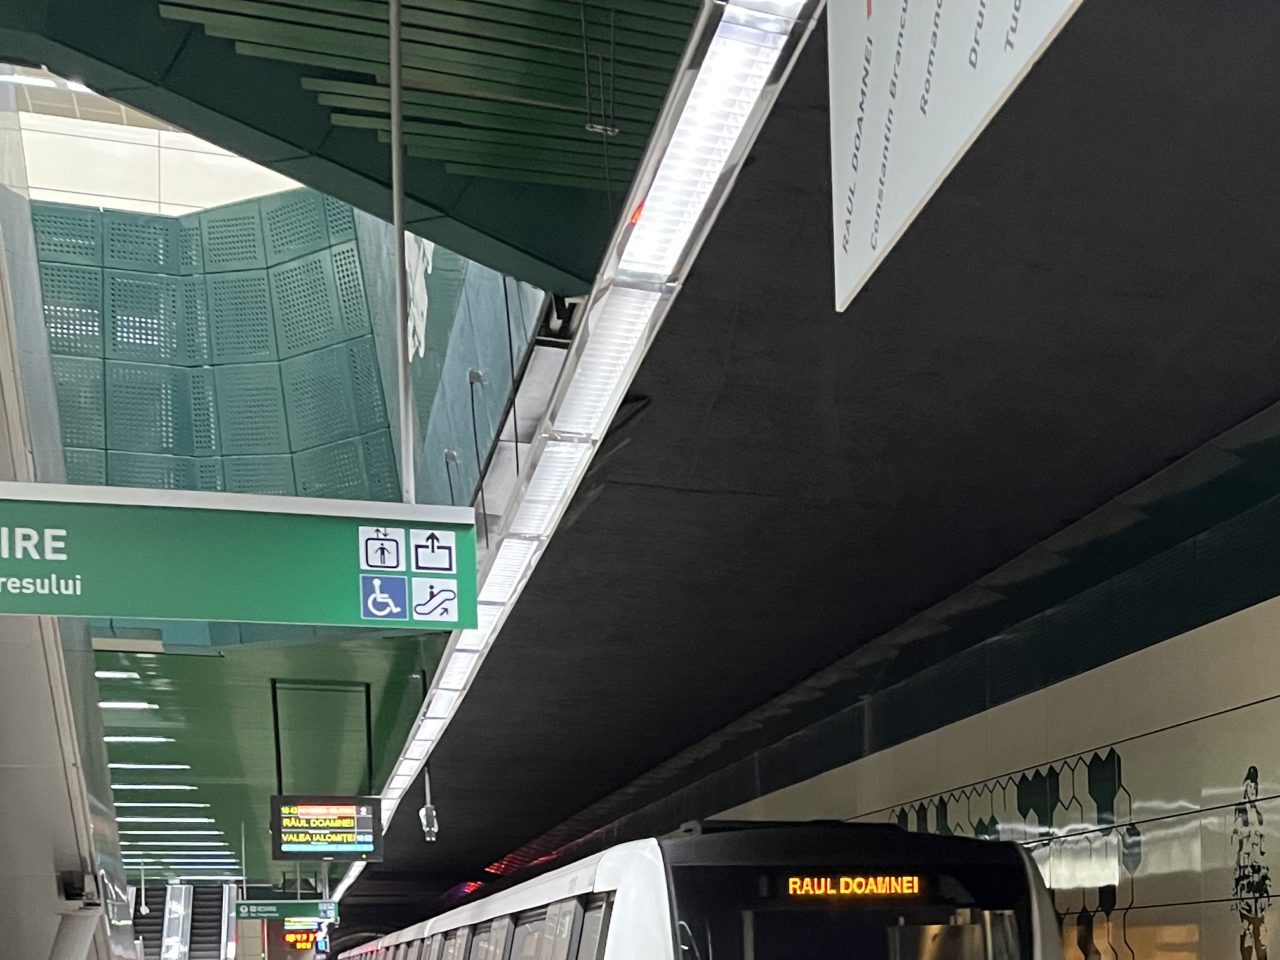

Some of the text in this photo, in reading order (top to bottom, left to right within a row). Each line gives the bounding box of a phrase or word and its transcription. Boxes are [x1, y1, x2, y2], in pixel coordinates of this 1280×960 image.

[842, 35, 873, 254] RAUL DOAMNEI
[870, 108, 894, 251] Constantin
[0, 526, 68, 560] IRE
[310, 818, 354, 828] DOAMNEI
[281, 833, 311, 842] VALEA
[788, 876, 919, 895] RAUL DOAMNEI
